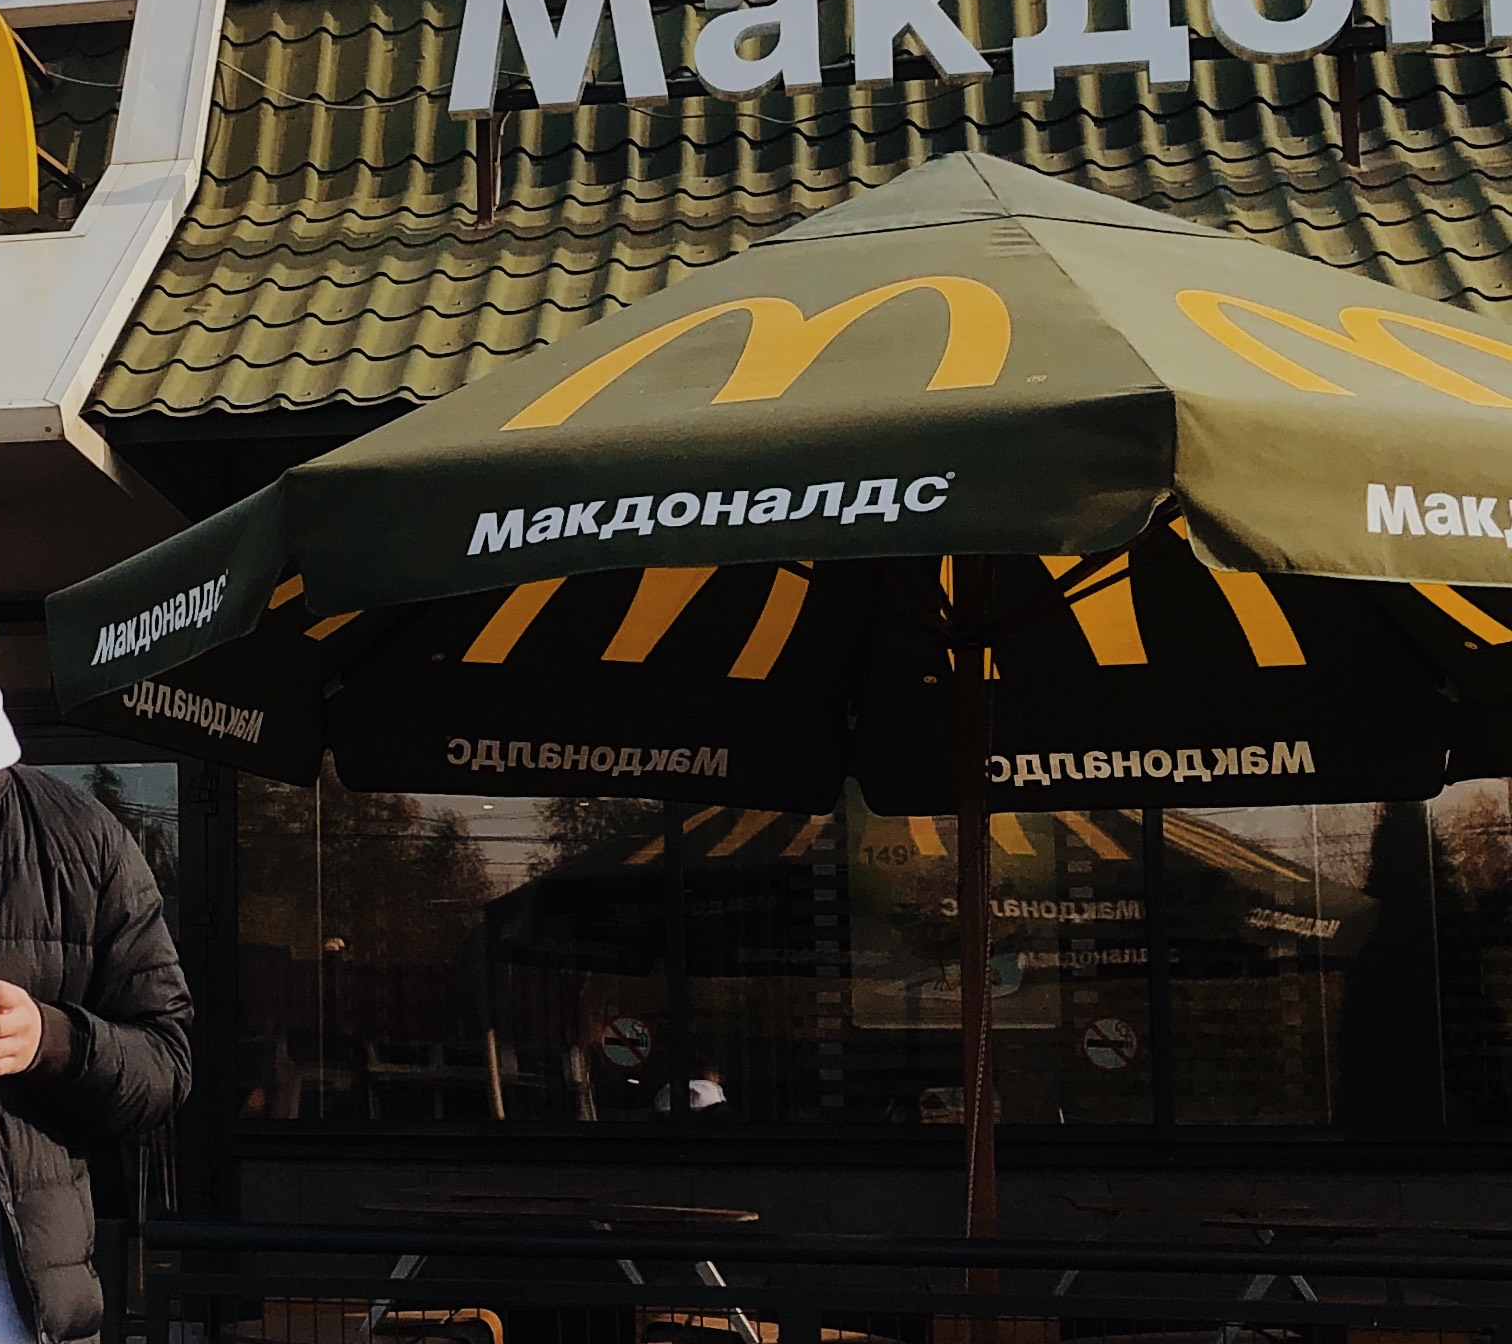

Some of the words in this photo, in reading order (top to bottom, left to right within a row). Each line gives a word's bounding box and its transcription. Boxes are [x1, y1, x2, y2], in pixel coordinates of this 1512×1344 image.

[467, 474, 951, 556] Макдоналдс
[1367, 483, 1512, 549] Мак
[91, 573, 227, 666] Макдоналдс
